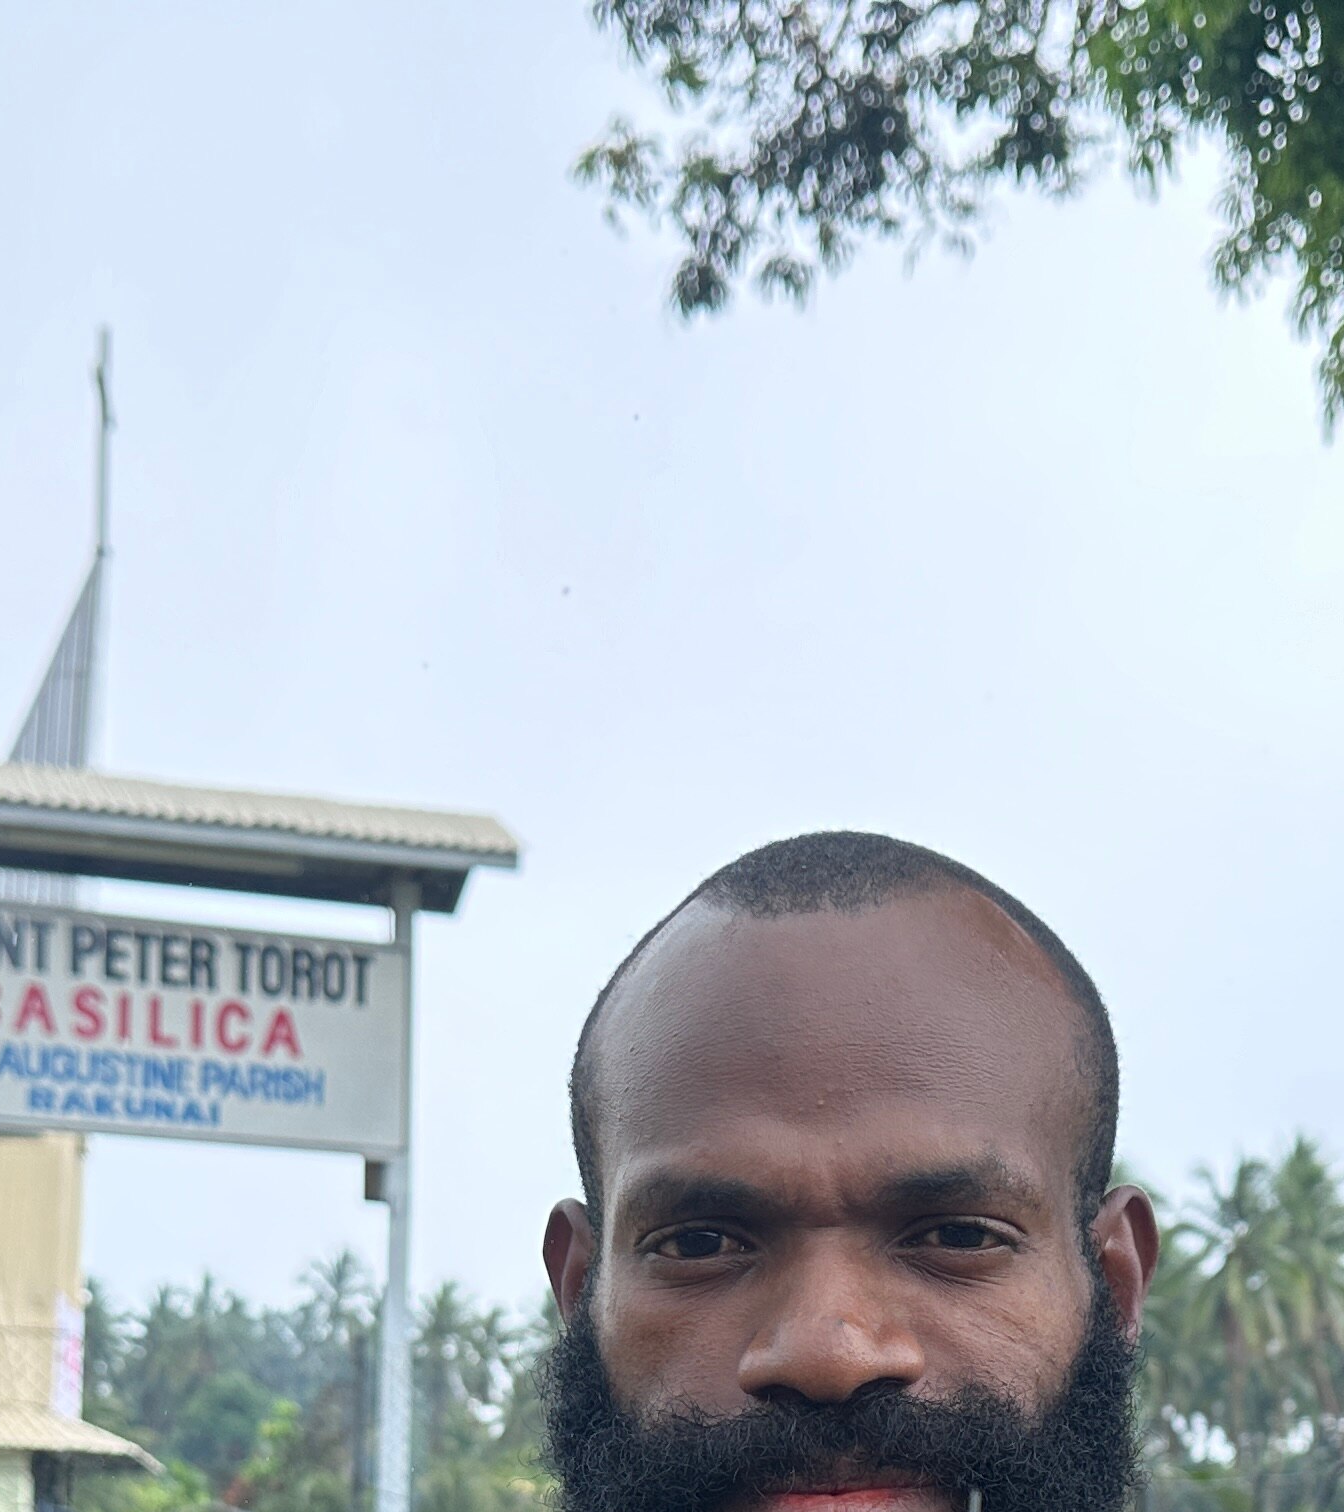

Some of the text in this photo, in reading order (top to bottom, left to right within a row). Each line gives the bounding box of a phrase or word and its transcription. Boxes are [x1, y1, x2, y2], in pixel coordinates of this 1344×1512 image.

[71, 924, 216, 990] PETER
[234, 940, 374, 1006] TOROT
[200, 1060, 326, 1105] PARISH
